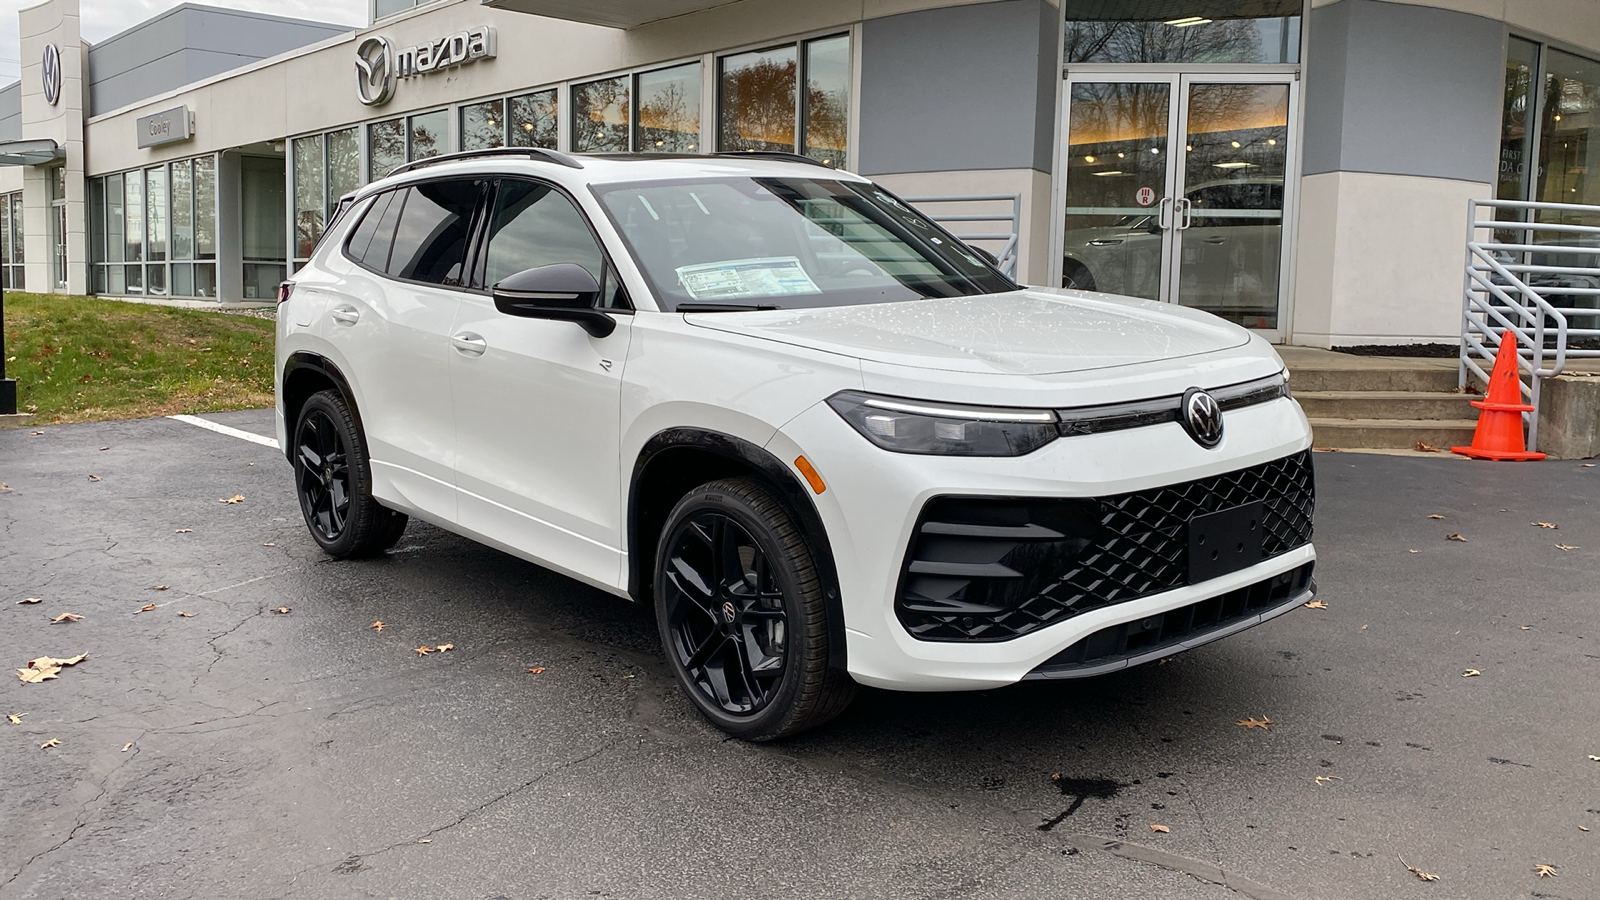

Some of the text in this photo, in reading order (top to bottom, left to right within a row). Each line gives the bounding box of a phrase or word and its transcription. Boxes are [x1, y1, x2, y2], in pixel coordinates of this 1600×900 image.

[149, 114, 171, 137] Cooley
[1502, 149, 1522, 160] FIRST
[1189, 392, 1222, 445] VW
